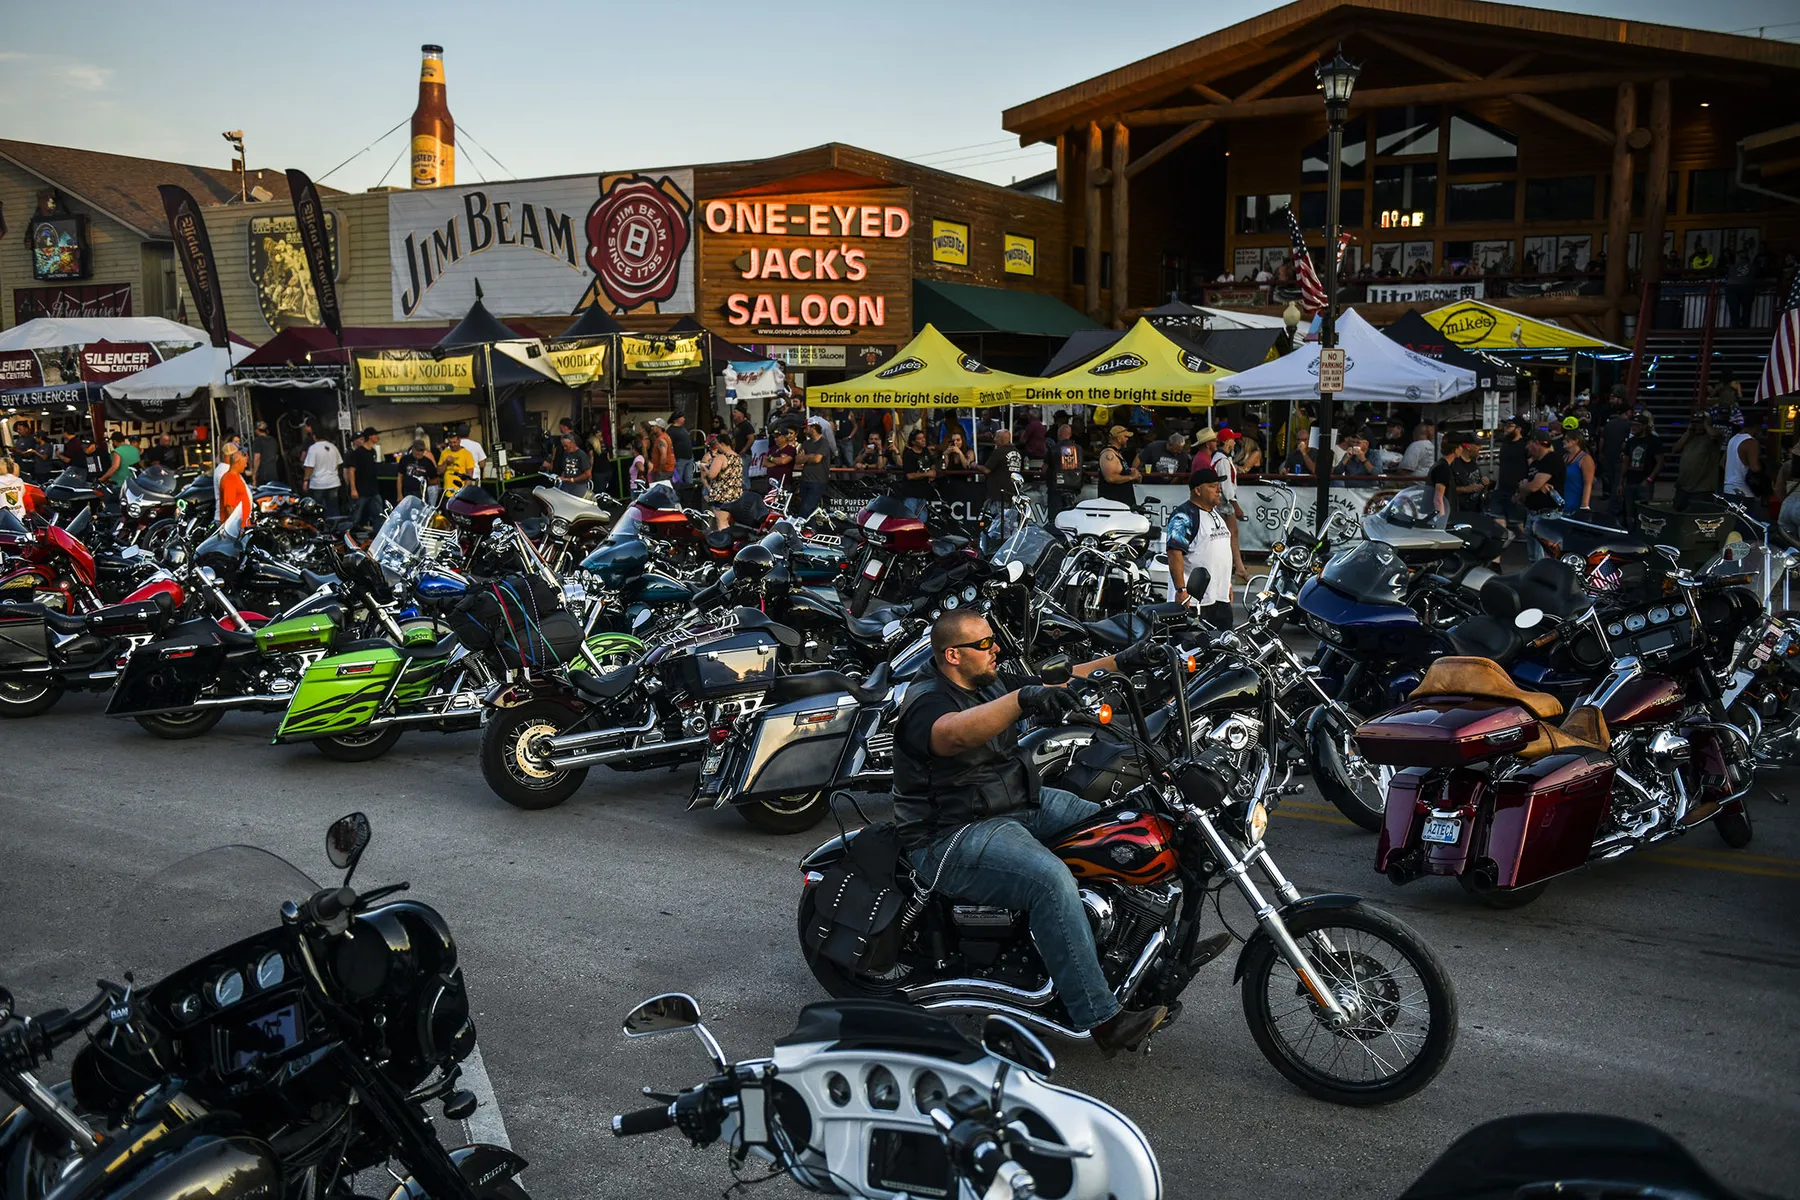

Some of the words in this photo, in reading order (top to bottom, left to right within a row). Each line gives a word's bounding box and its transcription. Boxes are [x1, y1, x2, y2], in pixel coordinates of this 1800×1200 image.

[615, 205, 635, 225] JIM
[638, 204, 667, 240] BEAM
[704, 200, 911, 238] ONE-EYED
[623, 222, 650, 257] B
[933, 235, 955, 251] TWISTED
[955, 237, 965, 255] TEA
[401, 215, 463, 317] JIM
[460, 191, 582, 274] BEAM
[608, 237, 633, 278] SINCE
[636, 254, 662, 278] 1795
[741, 242, 868, 281] JACK'S
[1415, 289, 1457, 301] WELCOME
[727, 292, 885, 327] SALOON
[1446, 316, 1492, 335] mike's
[84, 352, 150, 365] SILENCER
[556, 353, 600, 369] NOODLES
[1095, 356, 1141, 372] mike's
[1327, 353, 1338, 361] NO
[363, 366, 399, 379] ISLAND
[419, 364, 467, 378] NOODLES
[882, 361, 922, 376] mike's
[2, 394, 20, 407] BUY
[22, 393, 30, 405] A
[31, 390, 79, 403] SILENCER
[820, 392, 850, 403] Drink
[855, 394, 868, 403] on
[873, 392, 891, 403] the
[894, 392, 930, 406] bright
[933, 393, 959, 404] side
[980, 390, 995, 402] Drink
[996, 391, 1003, 401] on
[1026, 388, 1061, 400] Drink
[1066, 389, 1084, 399] on
[1088, 388, 1110, 399] the
[1114, 388, 1158, 403] bright
[1160, 391, 1192, 403] side
[1427, 823, 1454, 837] AZTECA
